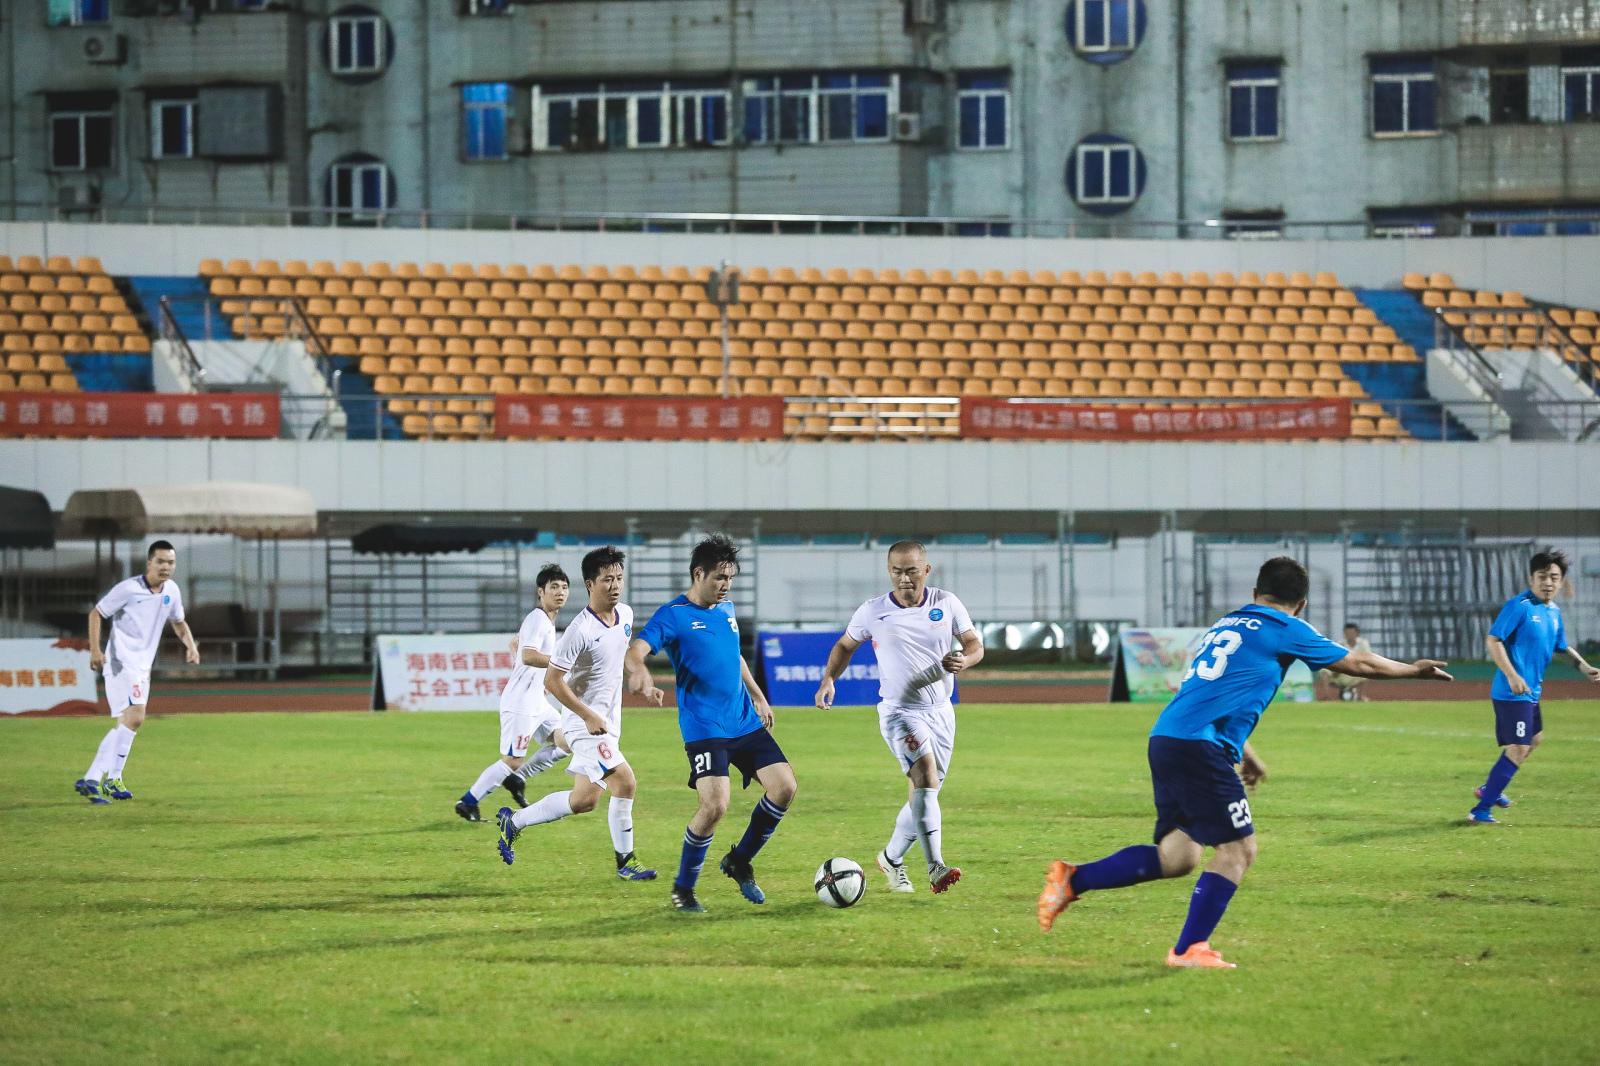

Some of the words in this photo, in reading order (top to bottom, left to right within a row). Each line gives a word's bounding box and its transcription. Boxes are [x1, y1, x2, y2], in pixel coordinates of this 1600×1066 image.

[145, 402, 266, 426] 青春飞扬
[406, 652, 513, 671] 海南省直属
[1515, 721, 1527, 738] 8
[597, 741, 613, 760] 6
[694, 751, 712, 775] 21
[1228, 798, 1252, 829] 23
